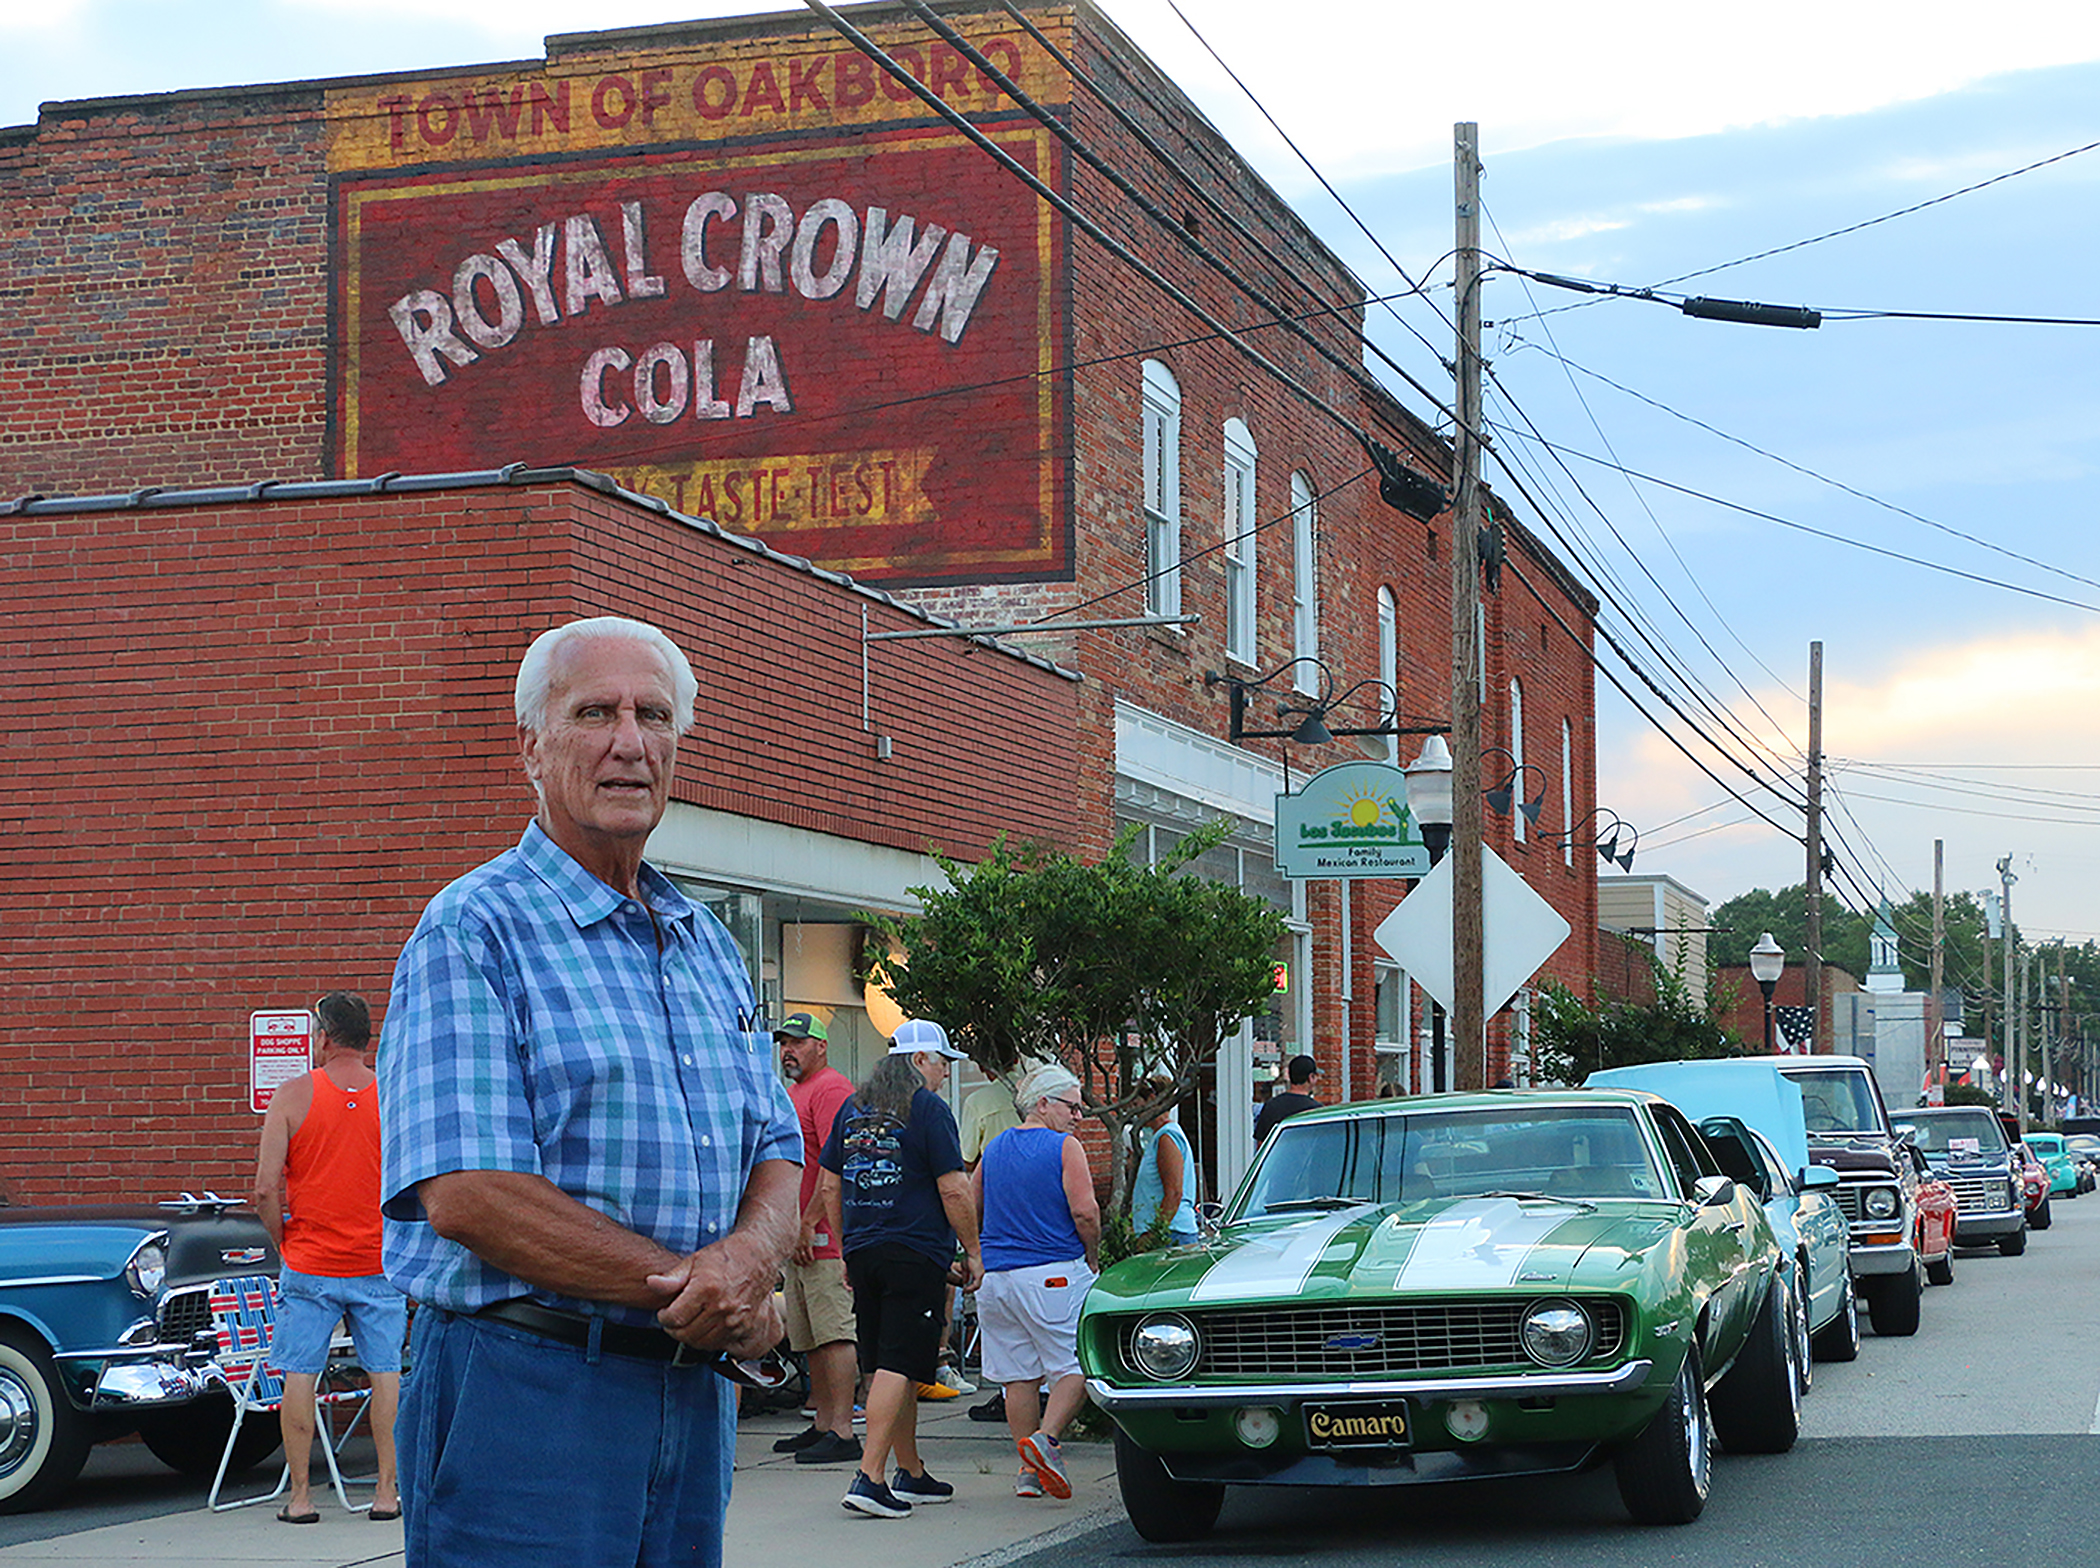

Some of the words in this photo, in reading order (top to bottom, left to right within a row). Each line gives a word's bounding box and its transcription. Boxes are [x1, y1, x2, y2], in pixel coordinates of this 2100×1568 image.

[377, 80, 571, 158] TOWN
[591, 68, 673, 130] OF
[692, 37, 1022, 121] OAKBORO
[387, 201, 667, 387] ROYAL
[680, 191, 1001, 344] CROWN
[580, 335, 793, 428] COLA
[1300, 822, 1328, 839] Los
[1317, 857, 1358, 868] Mexican
[1360, 857, 1416, 868] Restaurant
[1348, 847, 1383, 858] Family
[257, 1047, 286, 1055] PARKING
[287, 1046, 306, 1054] ONLY
[1310, 1411, 1406, 1438] Camaro
